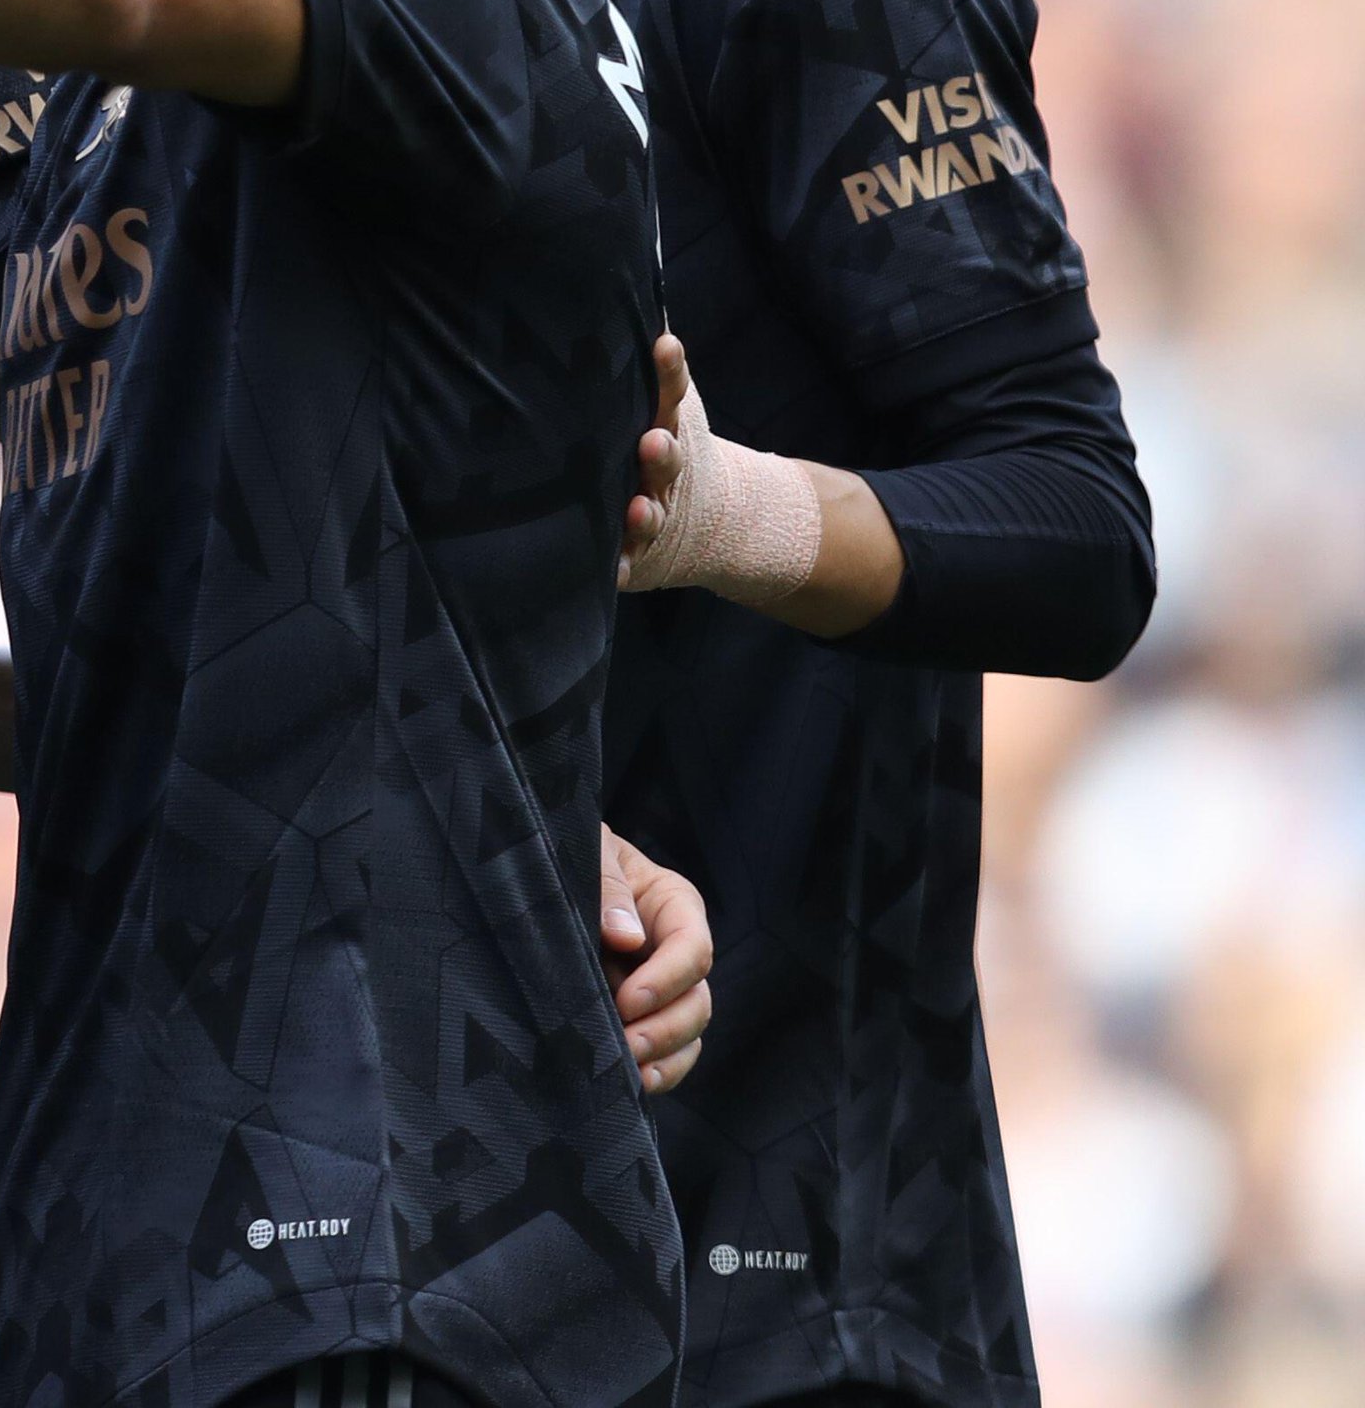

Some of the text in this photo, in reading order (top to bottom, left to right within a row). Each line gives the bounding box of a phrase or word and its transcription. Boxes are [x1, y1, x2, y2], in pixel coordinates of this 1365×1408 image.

[876, 71, 1001, 144] VISI
[277, 1217, 351, 1241] HEAT.RDY
[744, 1250, 808, 1272] HEAT.RDY
